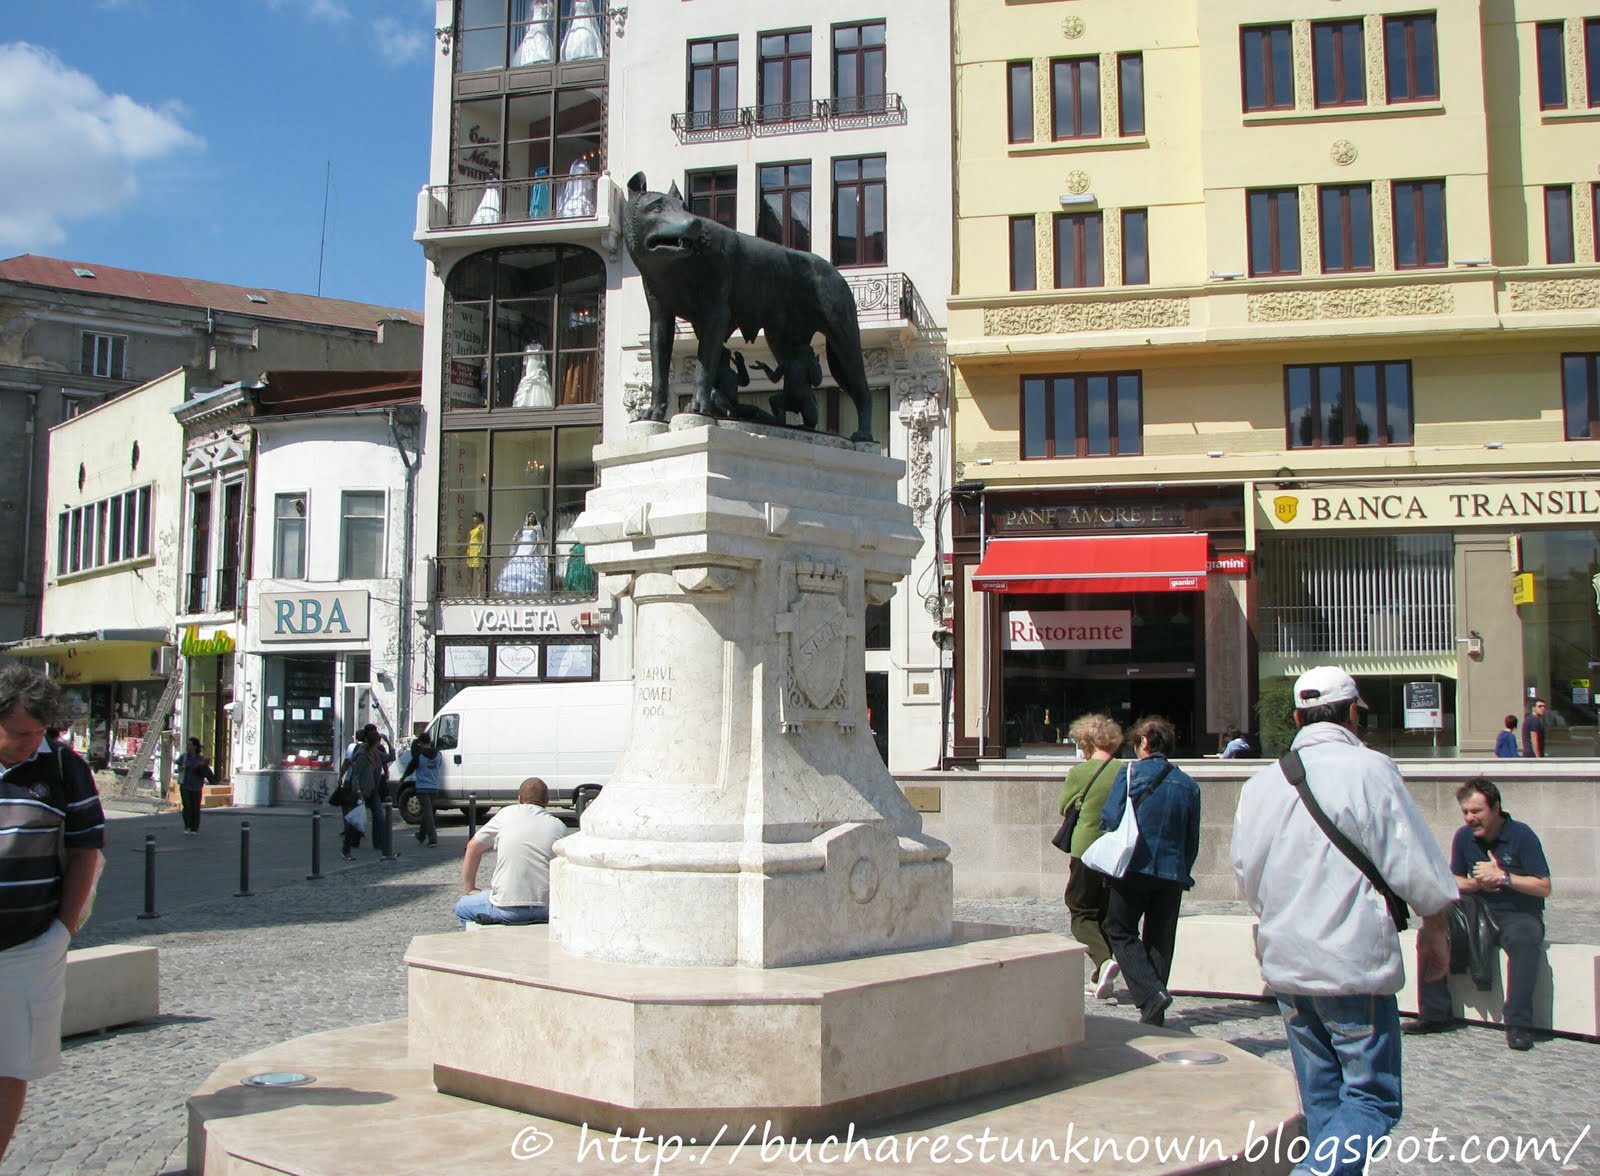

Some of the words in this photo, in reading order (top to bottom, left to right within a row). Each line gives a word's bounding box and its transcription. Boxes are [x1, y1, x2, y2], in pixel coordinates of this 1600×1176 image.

[1278, 503, 1294, 513] BT
[1311, 495, 1427, 521] BANCA
[1449, 490, 1600, 518] TRANSIL
[1007, 509, 1057, 525] PANE
[1206, 558, 1245, 571] granini
[982, 582, 1006, 590] granini
[1170, 578, 1195, 588] granini
[274, 598, 351, 634] RBA
[470, 609, 560, 632] VOALETA
[1010, 620, 1124, 642] Ristorante
